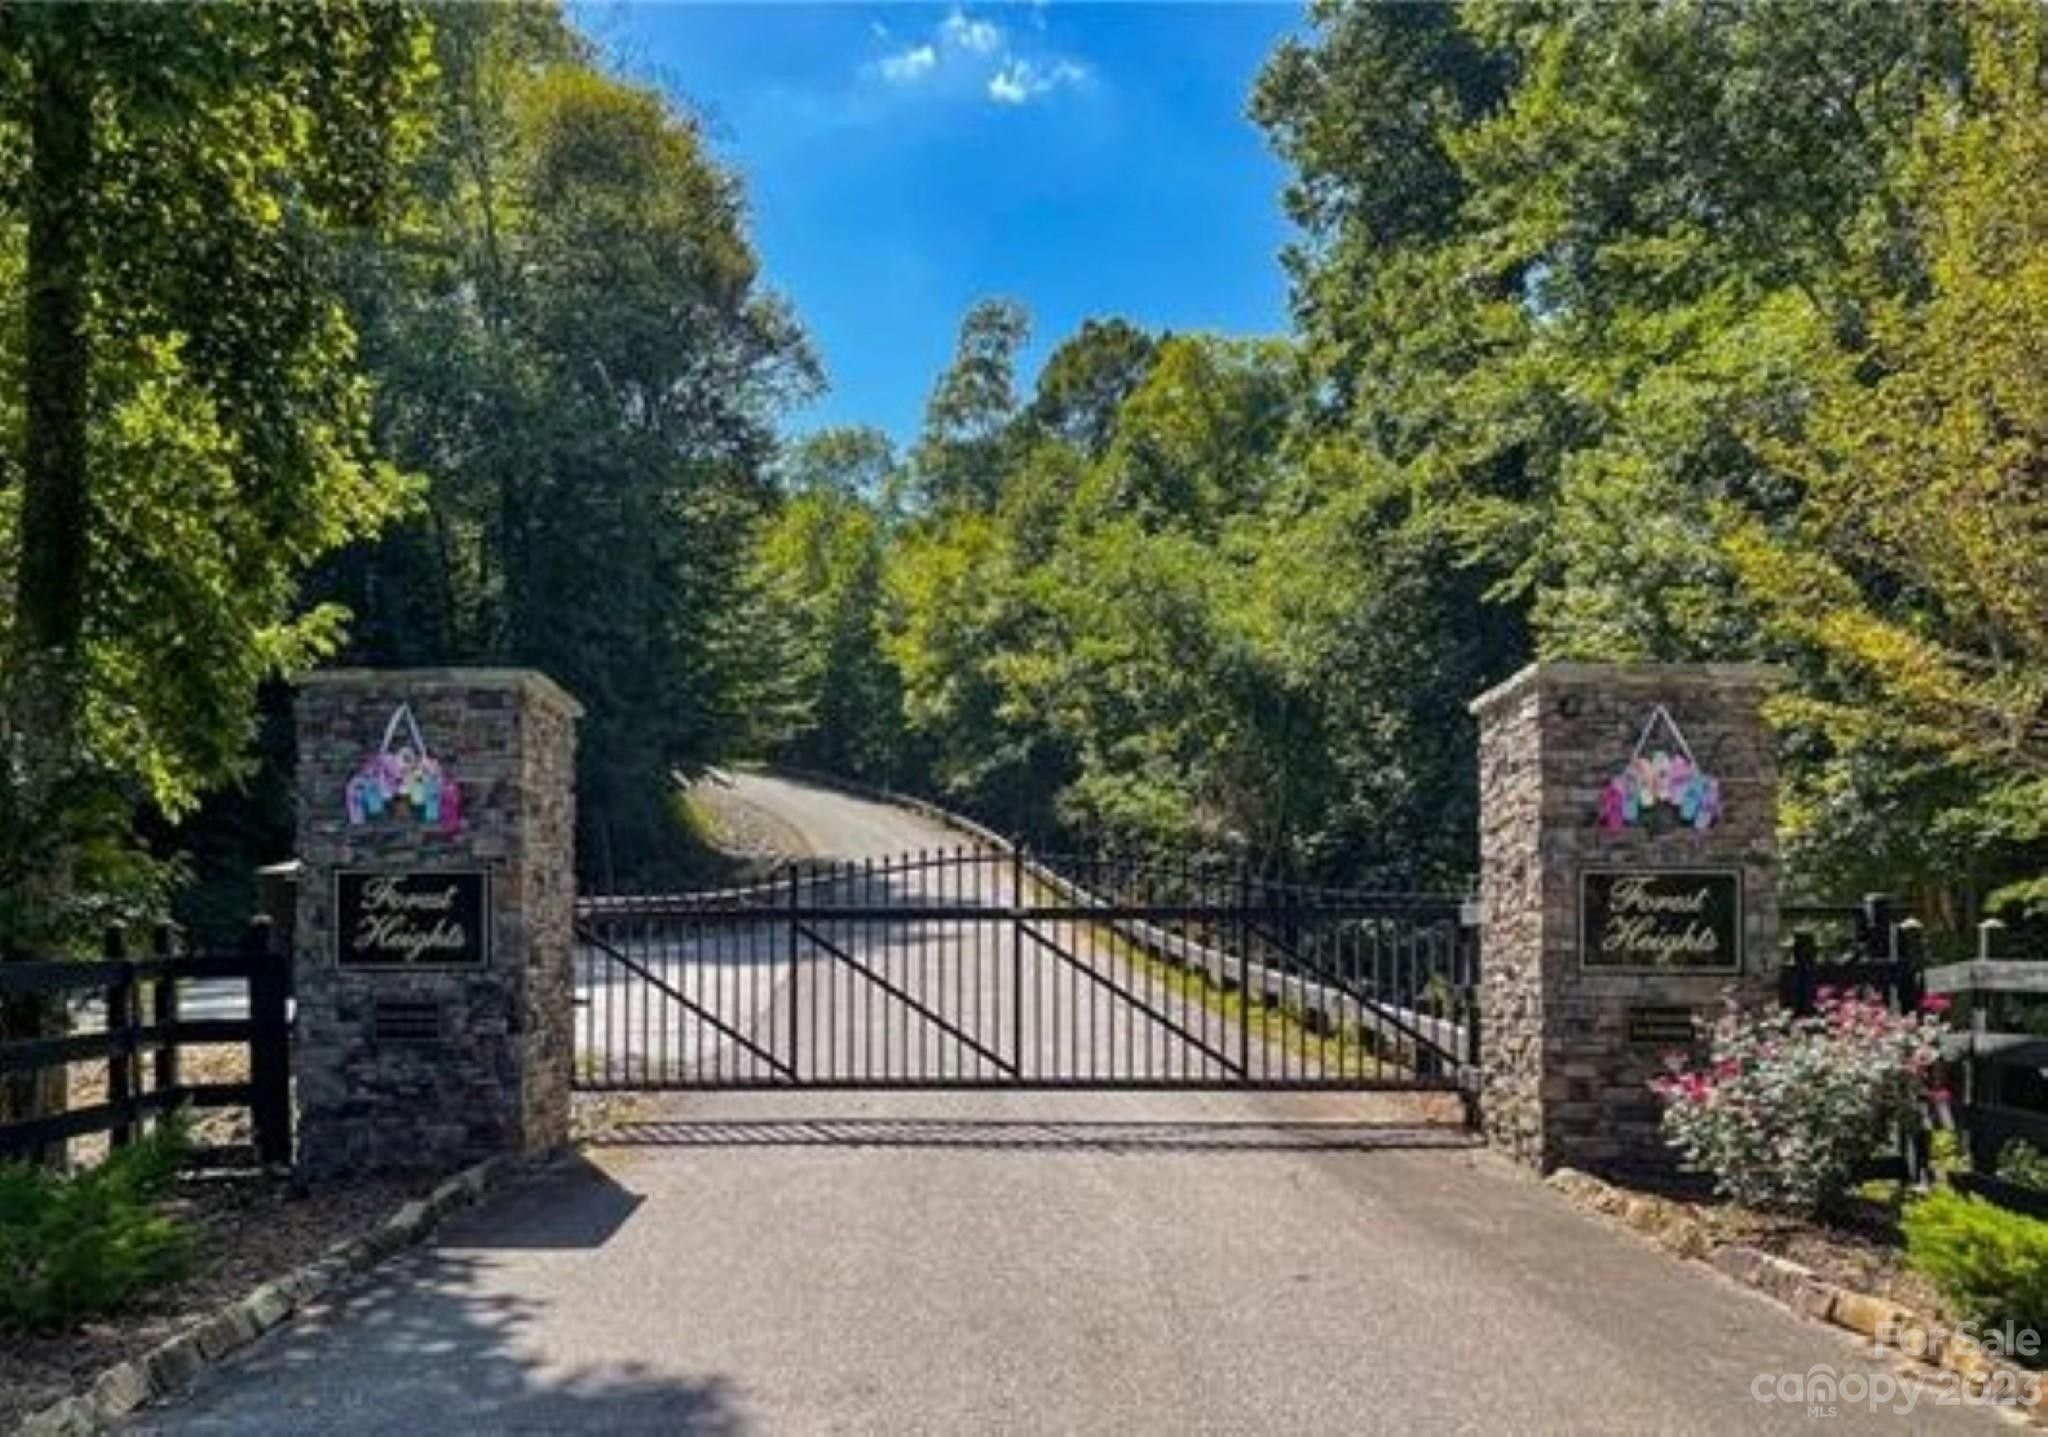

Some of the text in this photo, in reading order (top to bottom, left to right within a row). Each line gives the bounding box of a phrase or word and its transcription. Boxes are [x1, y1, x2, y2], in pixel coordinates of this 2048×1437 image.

[360, 876, 459, 909] Forest
[1609, 875, 1709, 911] Forest
[353, 914, 466, 961] Heights
[1602, 914, 1719, 964] Heights
